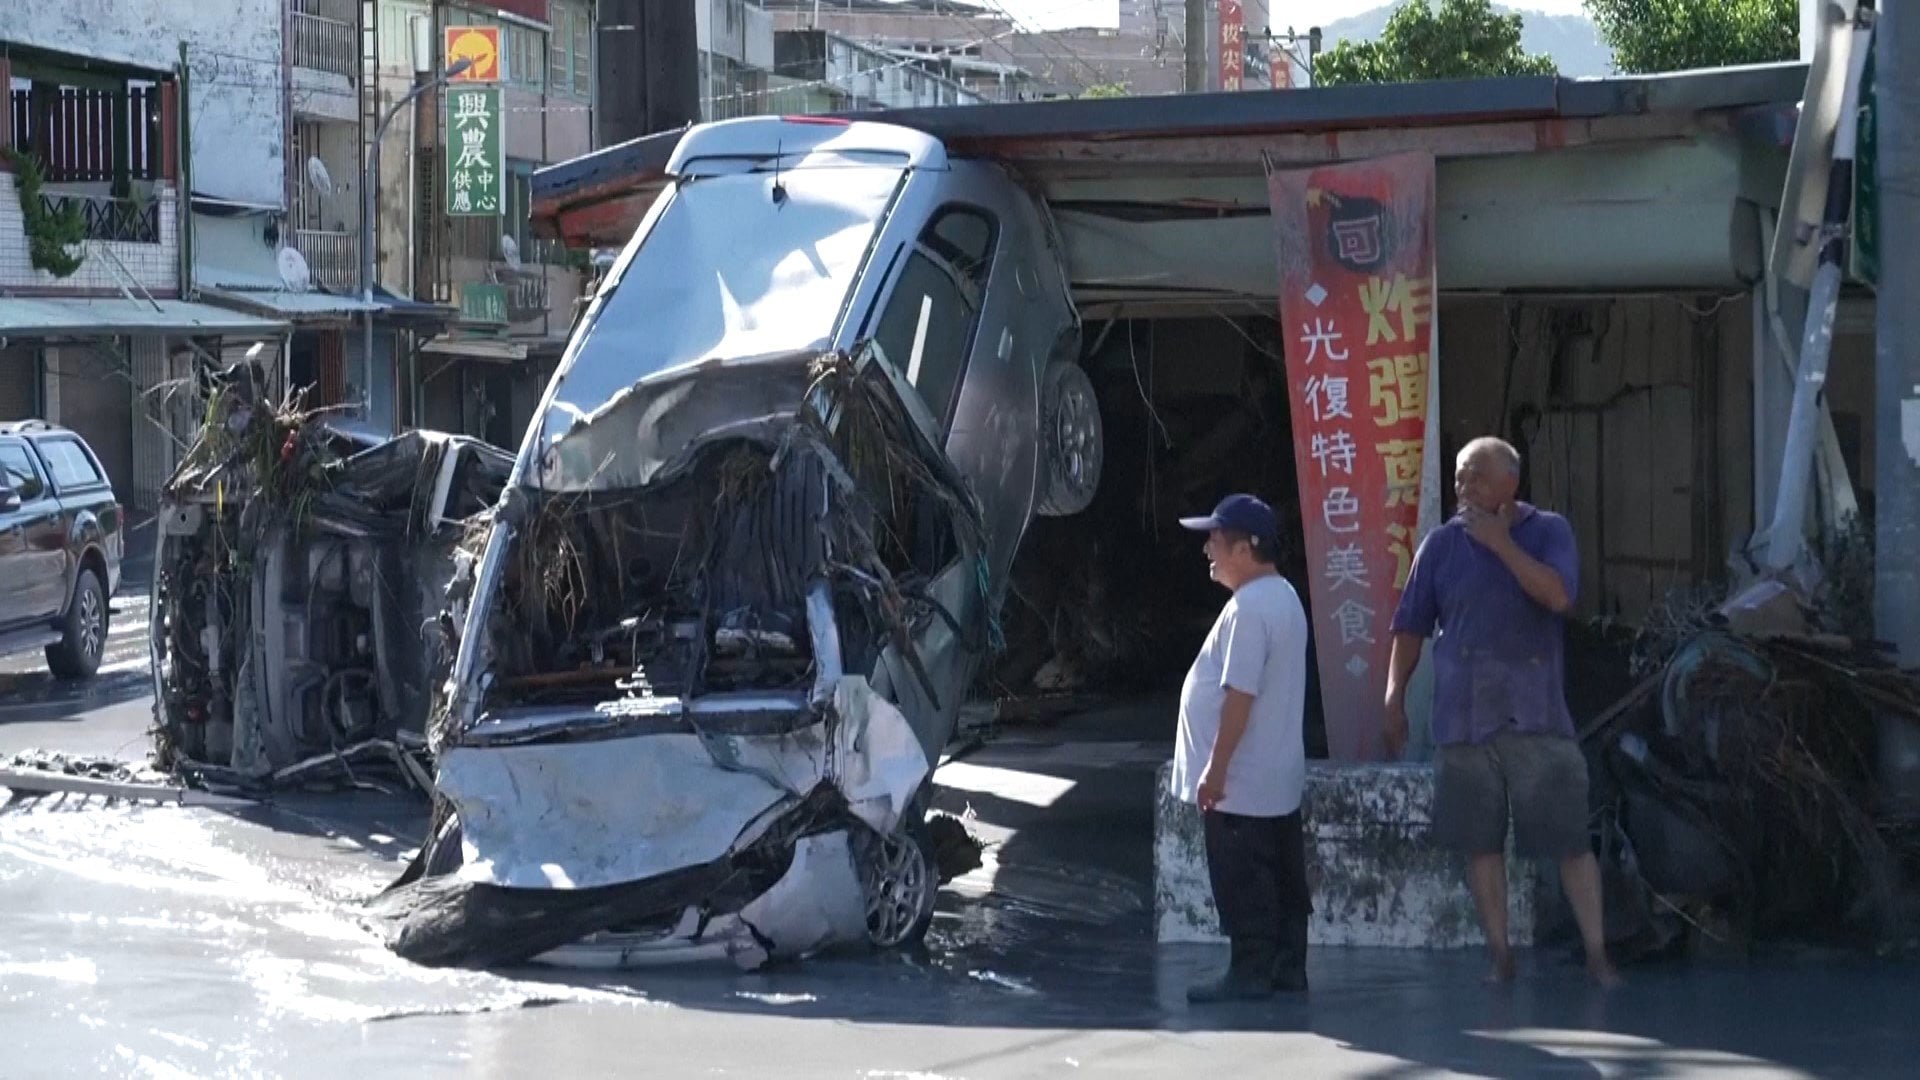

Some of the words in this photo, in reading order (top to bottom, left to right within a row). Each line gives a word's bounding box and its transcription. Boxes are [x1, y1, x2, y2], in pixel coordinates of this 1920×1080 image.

[454, 93, 492, 168] 興農
[452, 169, 473, 212] 供應
[477, 169, 497, 211] 中心
[1300, 316, 1376, 645] 光復特色美食
